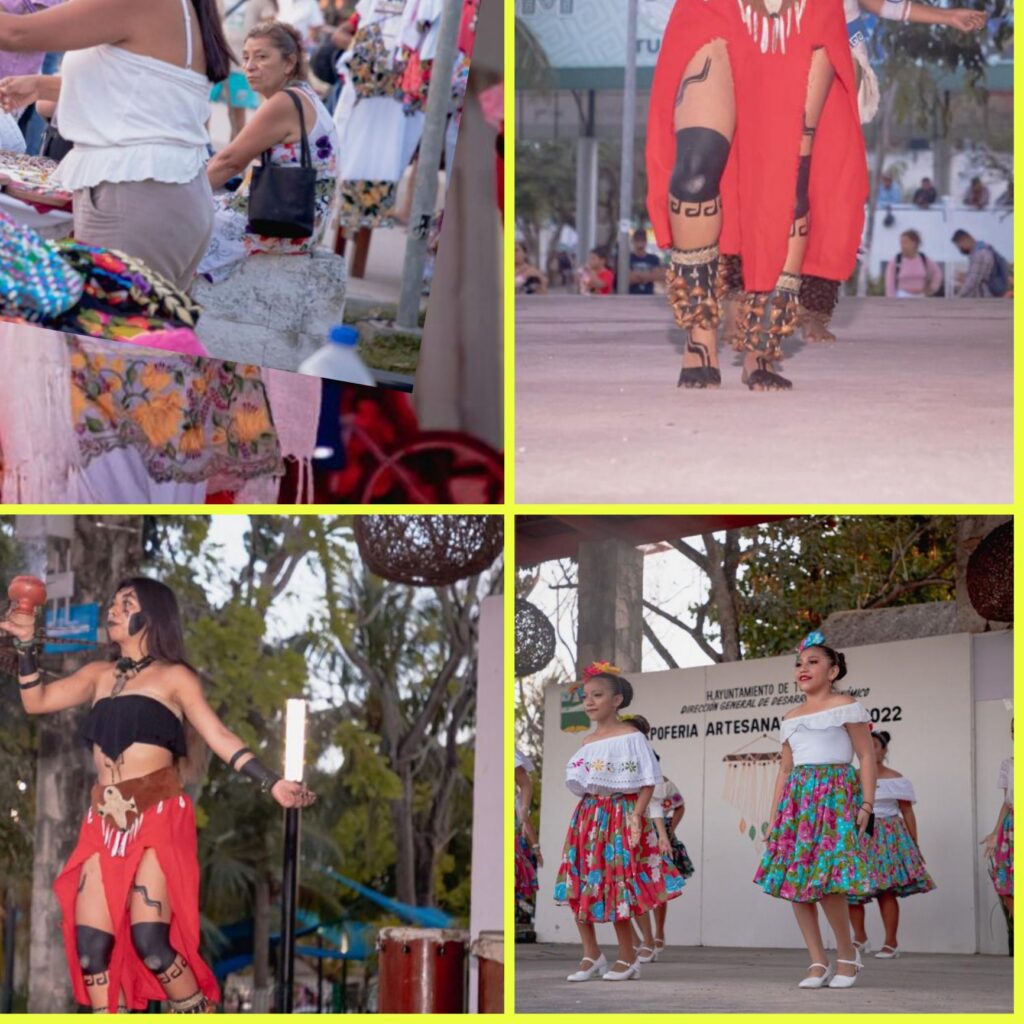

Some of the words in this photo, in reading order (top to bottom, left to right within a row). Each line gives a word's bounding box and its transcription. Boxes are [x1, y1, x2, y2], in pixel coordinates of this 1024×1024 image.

[778, 682, 789, 694] DE
[719, 699, 756, 711] GENERAL
[757, 696, 770, 707] DE
[647, 723, 698, 741] POFERIA
[705, 716, 784, 737] ARTESANA
[866, 706, 902, 723] 022
